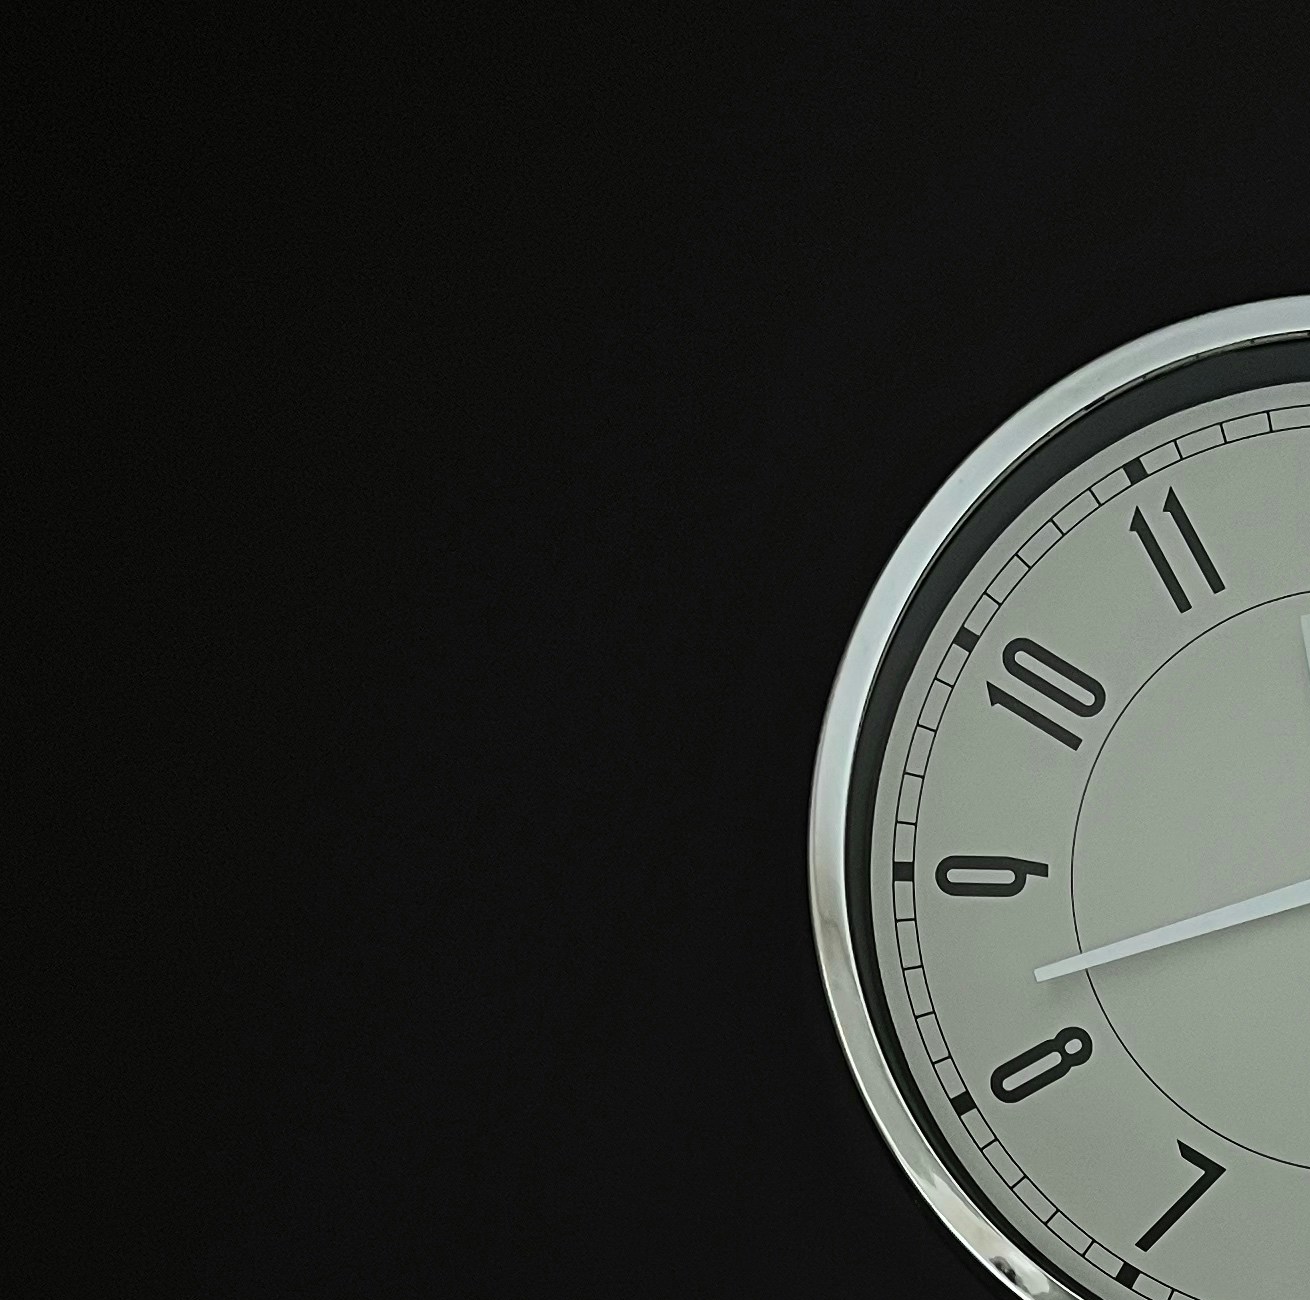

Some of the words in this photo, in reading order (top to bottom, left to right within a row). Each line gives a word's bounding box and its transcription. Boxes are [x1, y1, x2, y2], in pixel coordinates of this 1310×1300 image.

[1128, 485, 1226, 614] 11
[985, 637, 1107, 752] 10
[934, 855, 1049, 898] 9
[989, 1026, 1093, 1104] 8
[1134, 1138, 1227, 1253] 7
